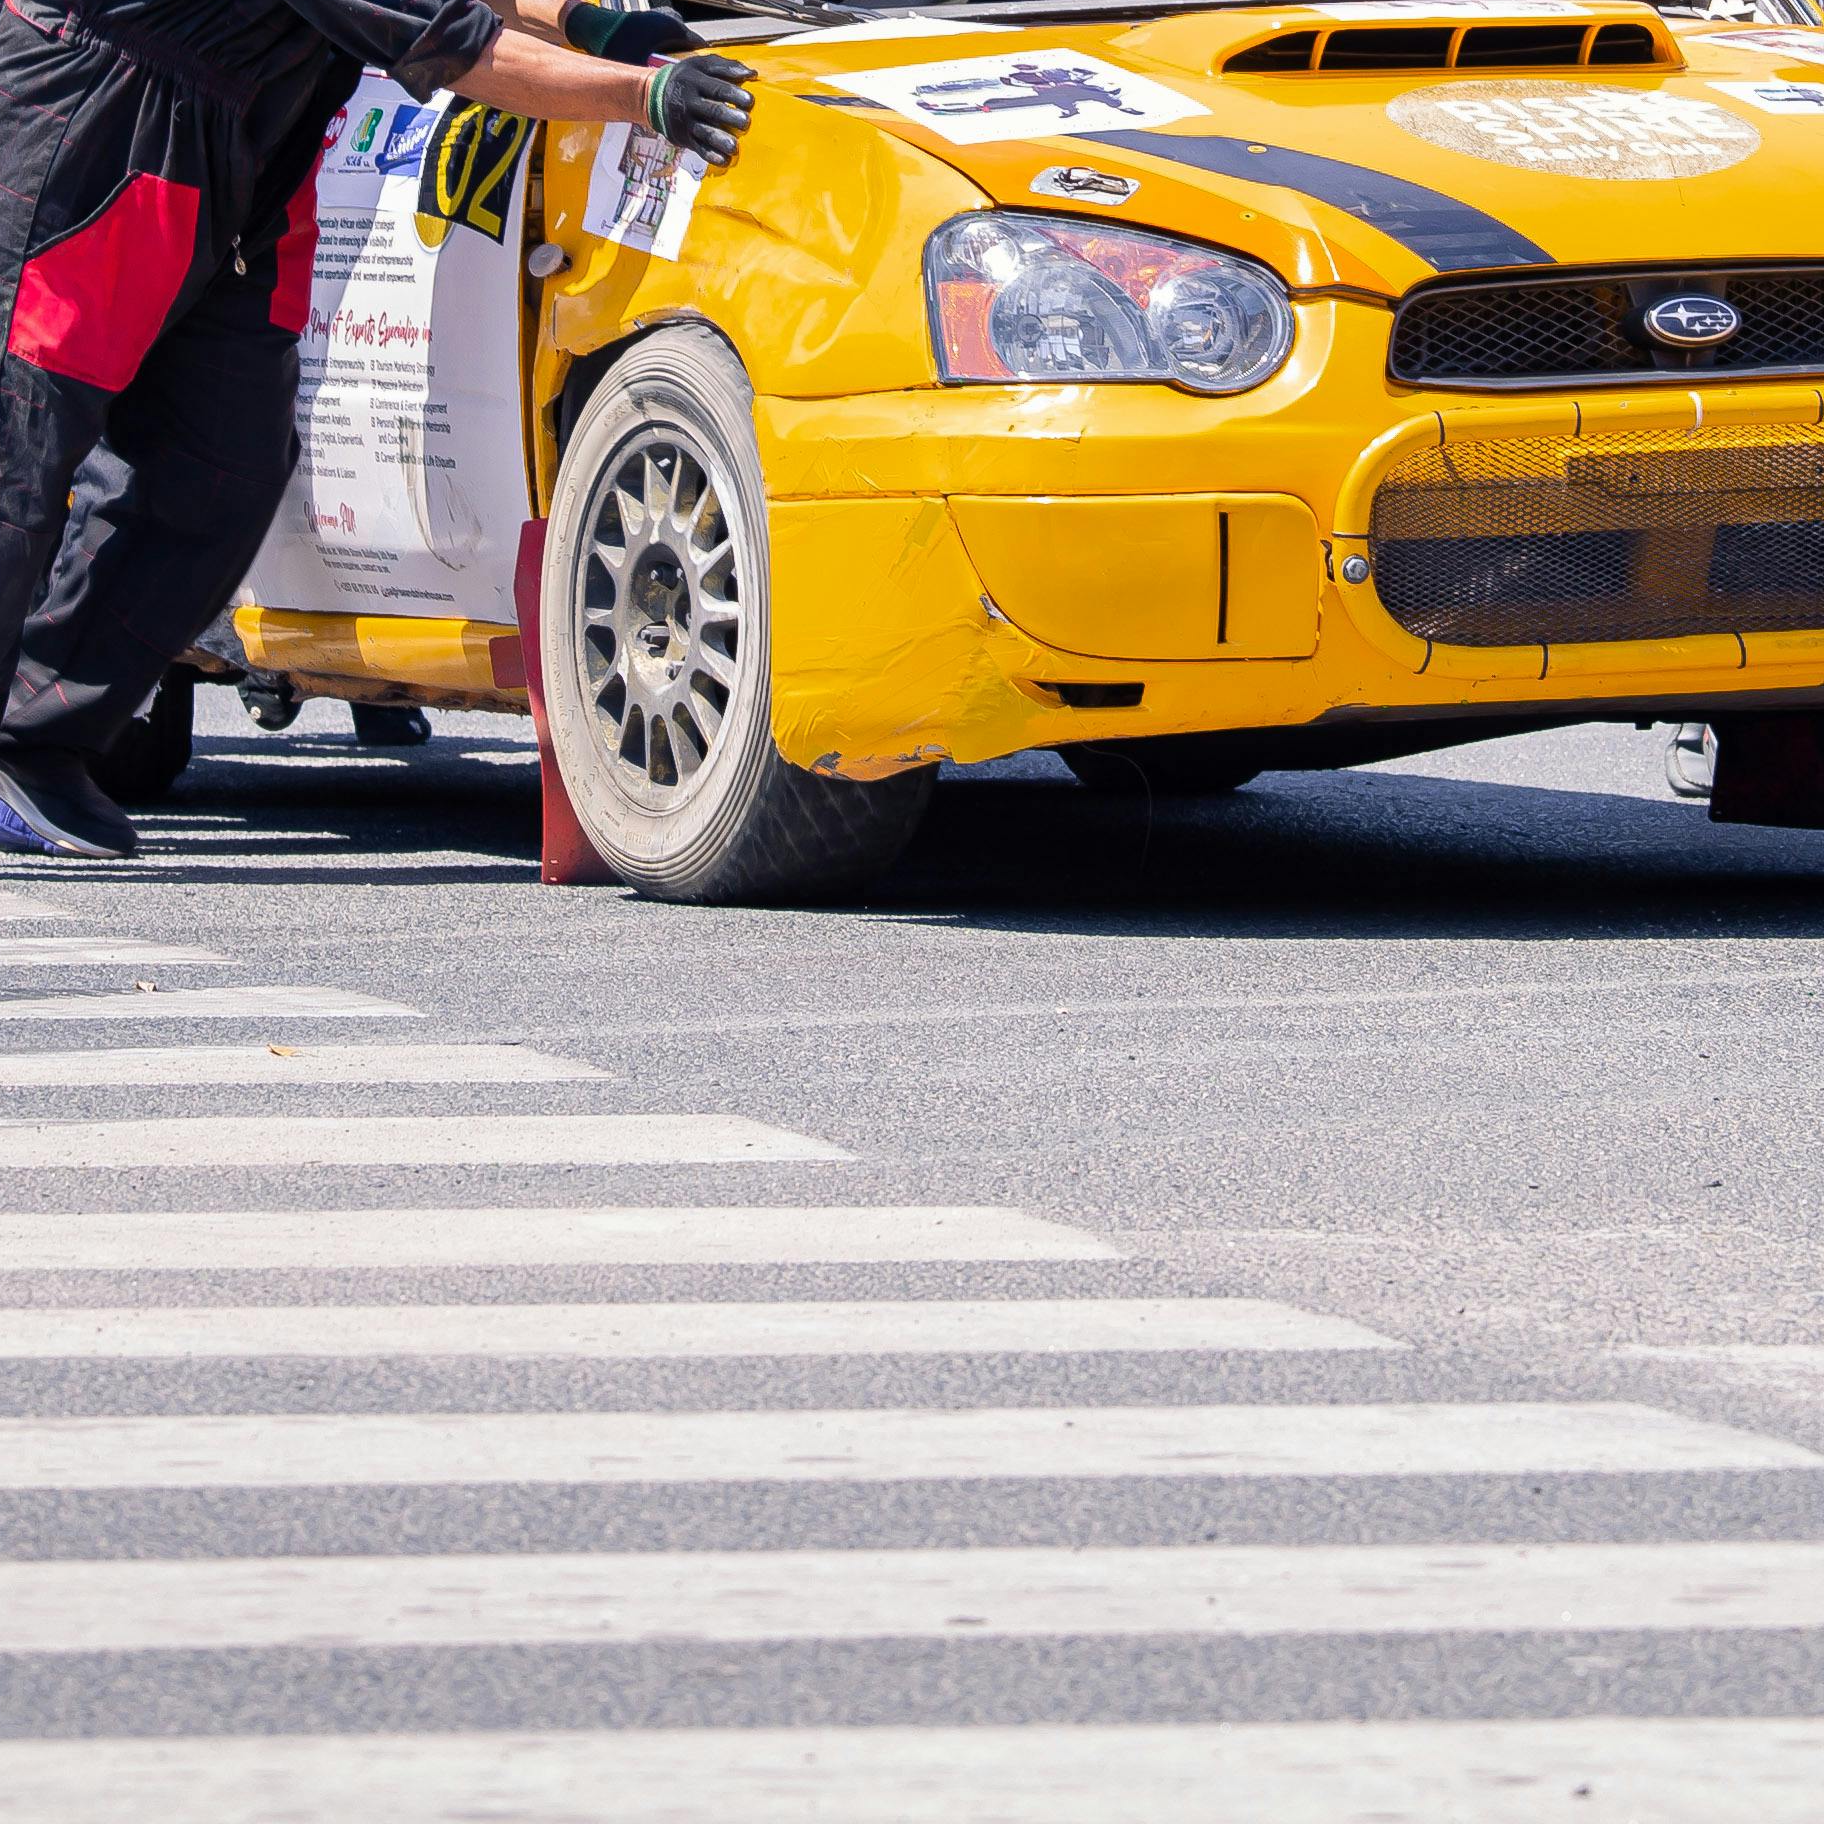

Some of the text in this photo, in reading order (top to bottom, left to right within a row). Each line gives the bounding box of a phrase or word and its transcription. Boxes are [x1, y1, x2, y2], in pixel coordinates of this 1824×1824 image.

[1435, 92, 1640, 123] RISE
[1475, 112, 1749, 144] SHINE
[1517, 140, 1722, 161] Rally Club
[436, 100, 529, 238] 02
